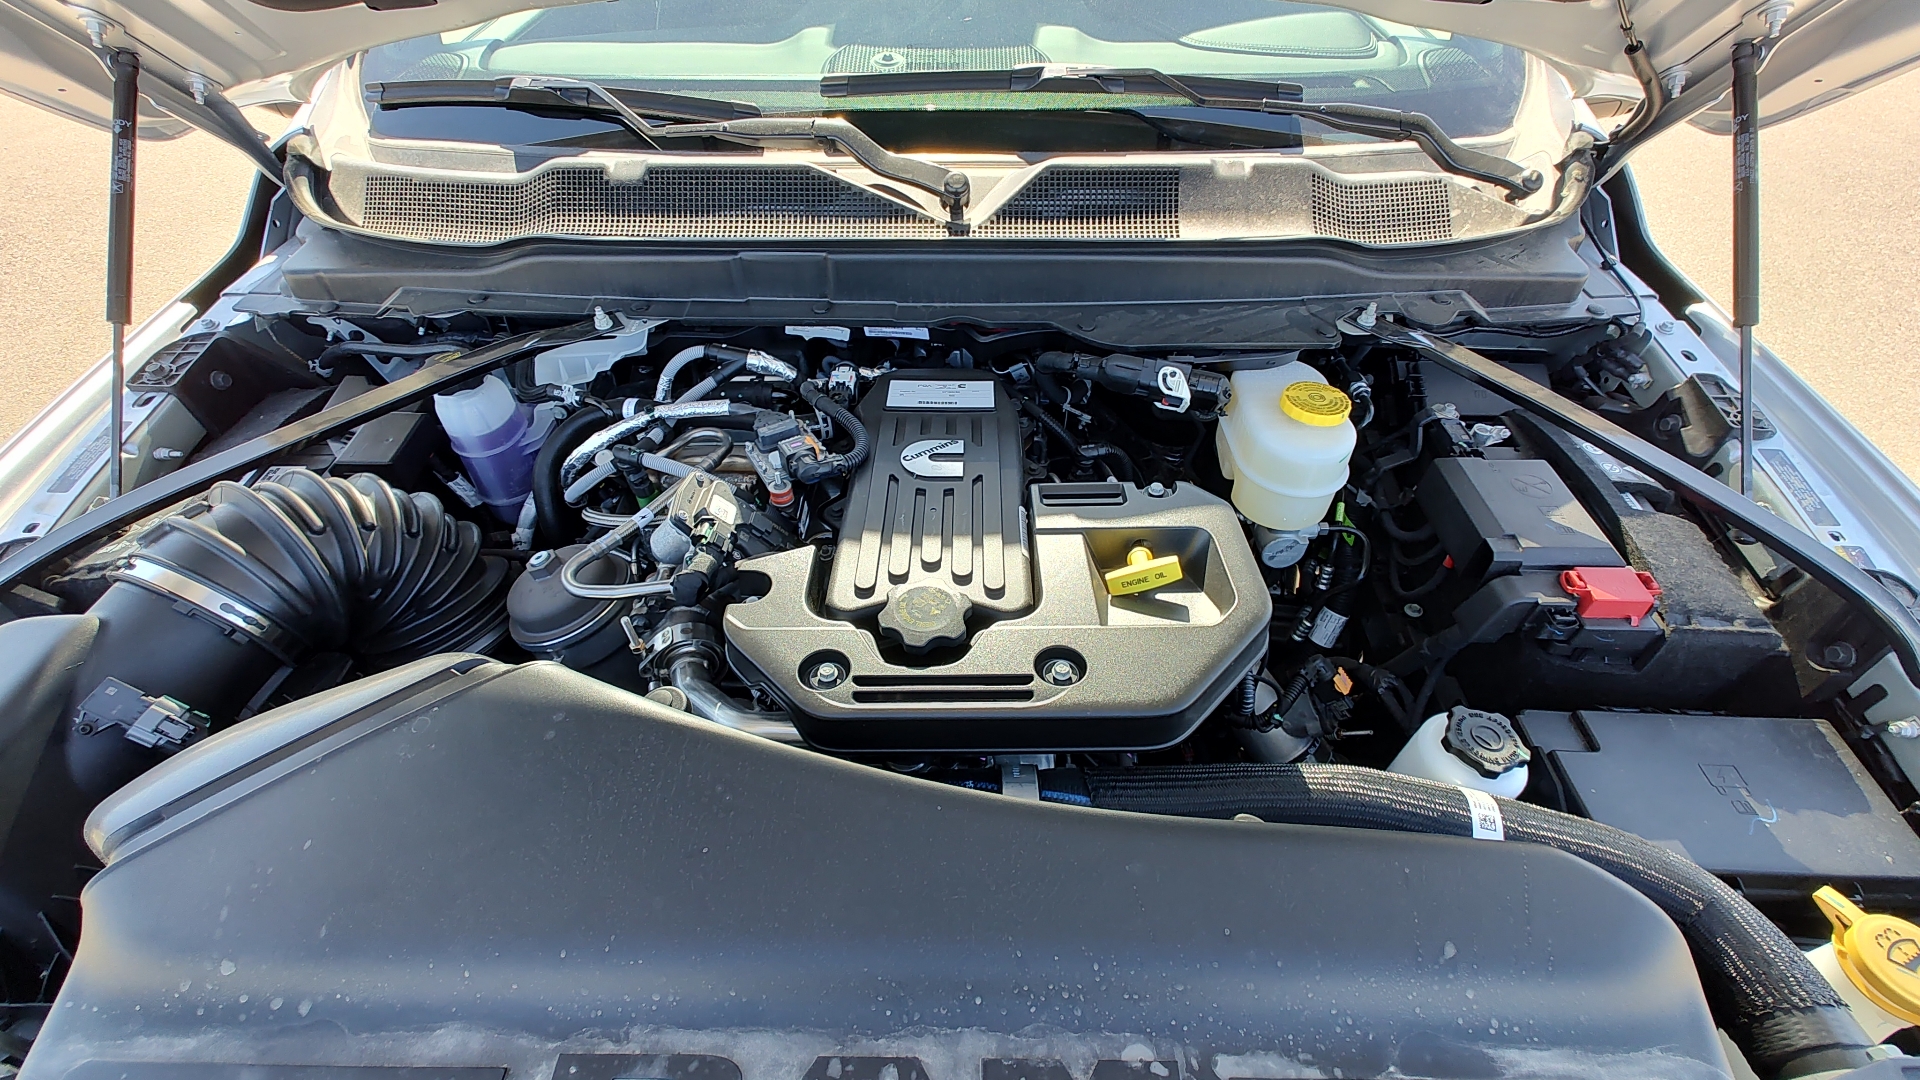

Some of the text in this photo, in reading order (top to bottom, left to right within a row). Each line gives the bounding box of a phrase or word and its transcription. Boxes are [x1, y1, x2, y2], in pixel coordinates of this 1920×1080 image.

[902, 440, 959, 461] Cummins
[1121, 572, 1167, 588] ENGINE OIL
